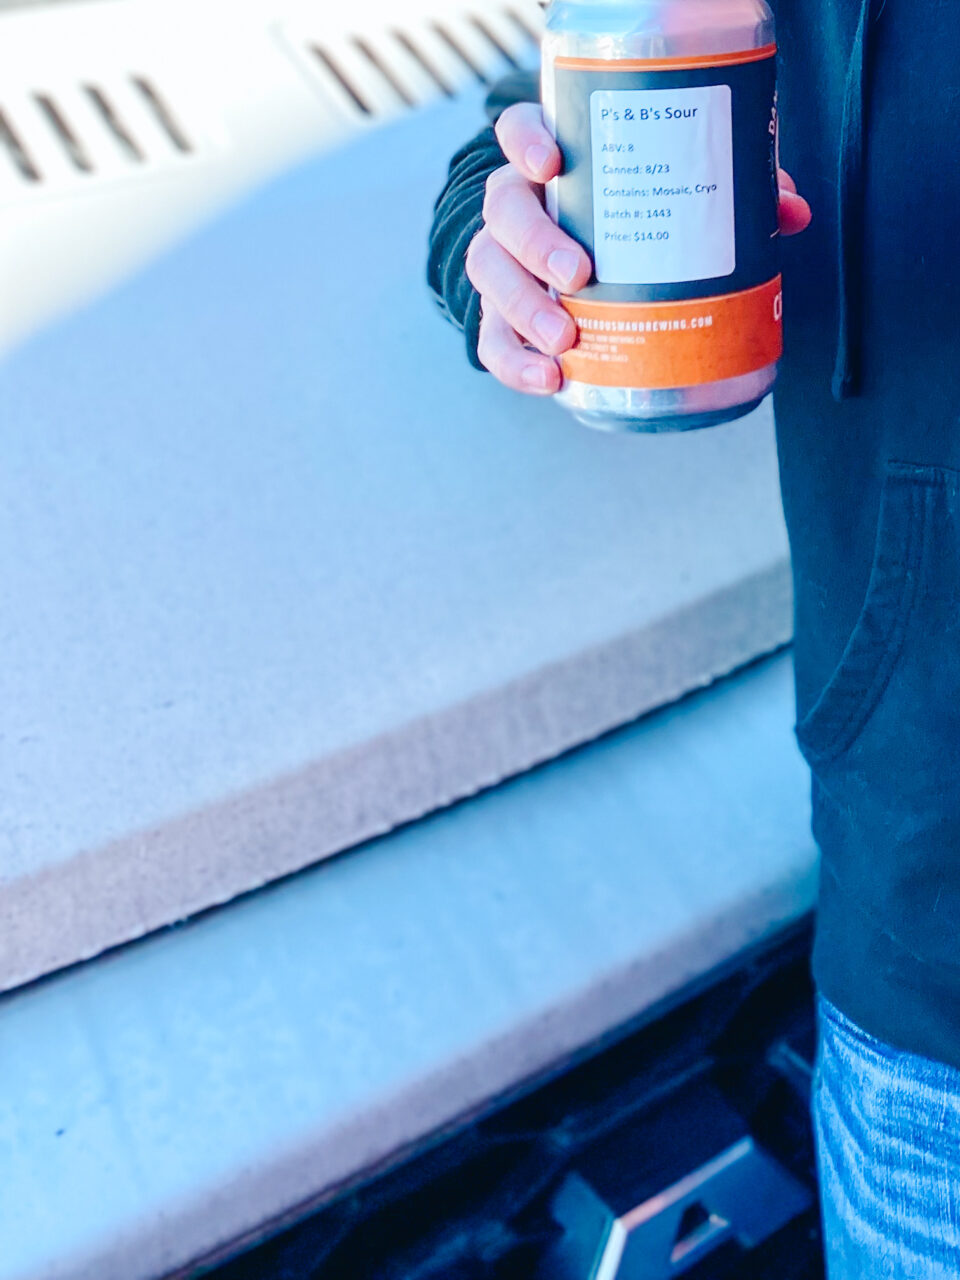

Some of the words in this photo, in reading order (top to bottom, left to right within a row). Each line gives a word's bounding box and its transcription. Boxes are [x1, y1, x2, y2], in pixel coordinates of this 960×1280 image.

[601, 108, 620, 121] P's
[624, 108, 635, 121] &
[640, 107, 660, 121] B's
[665, 106, 698, 120] Sour
[601, 143, 626, 153] ABV:
[627, 143, 635, 153] 8
[602, 164, 643, 175] Canned:
[645, 163, 670, 175] 8/23
[603, 187, 650, 197] Contains:
[652, 185, 693, 197] Mosaic,
[695, 184, 717, 195] Cryo
[604, 209, 632, 219] Batch
[646, 208, 672, 219] 1443
[604, 231, 632, 241] Price:
[633, 231, 670, 242] $14.00
